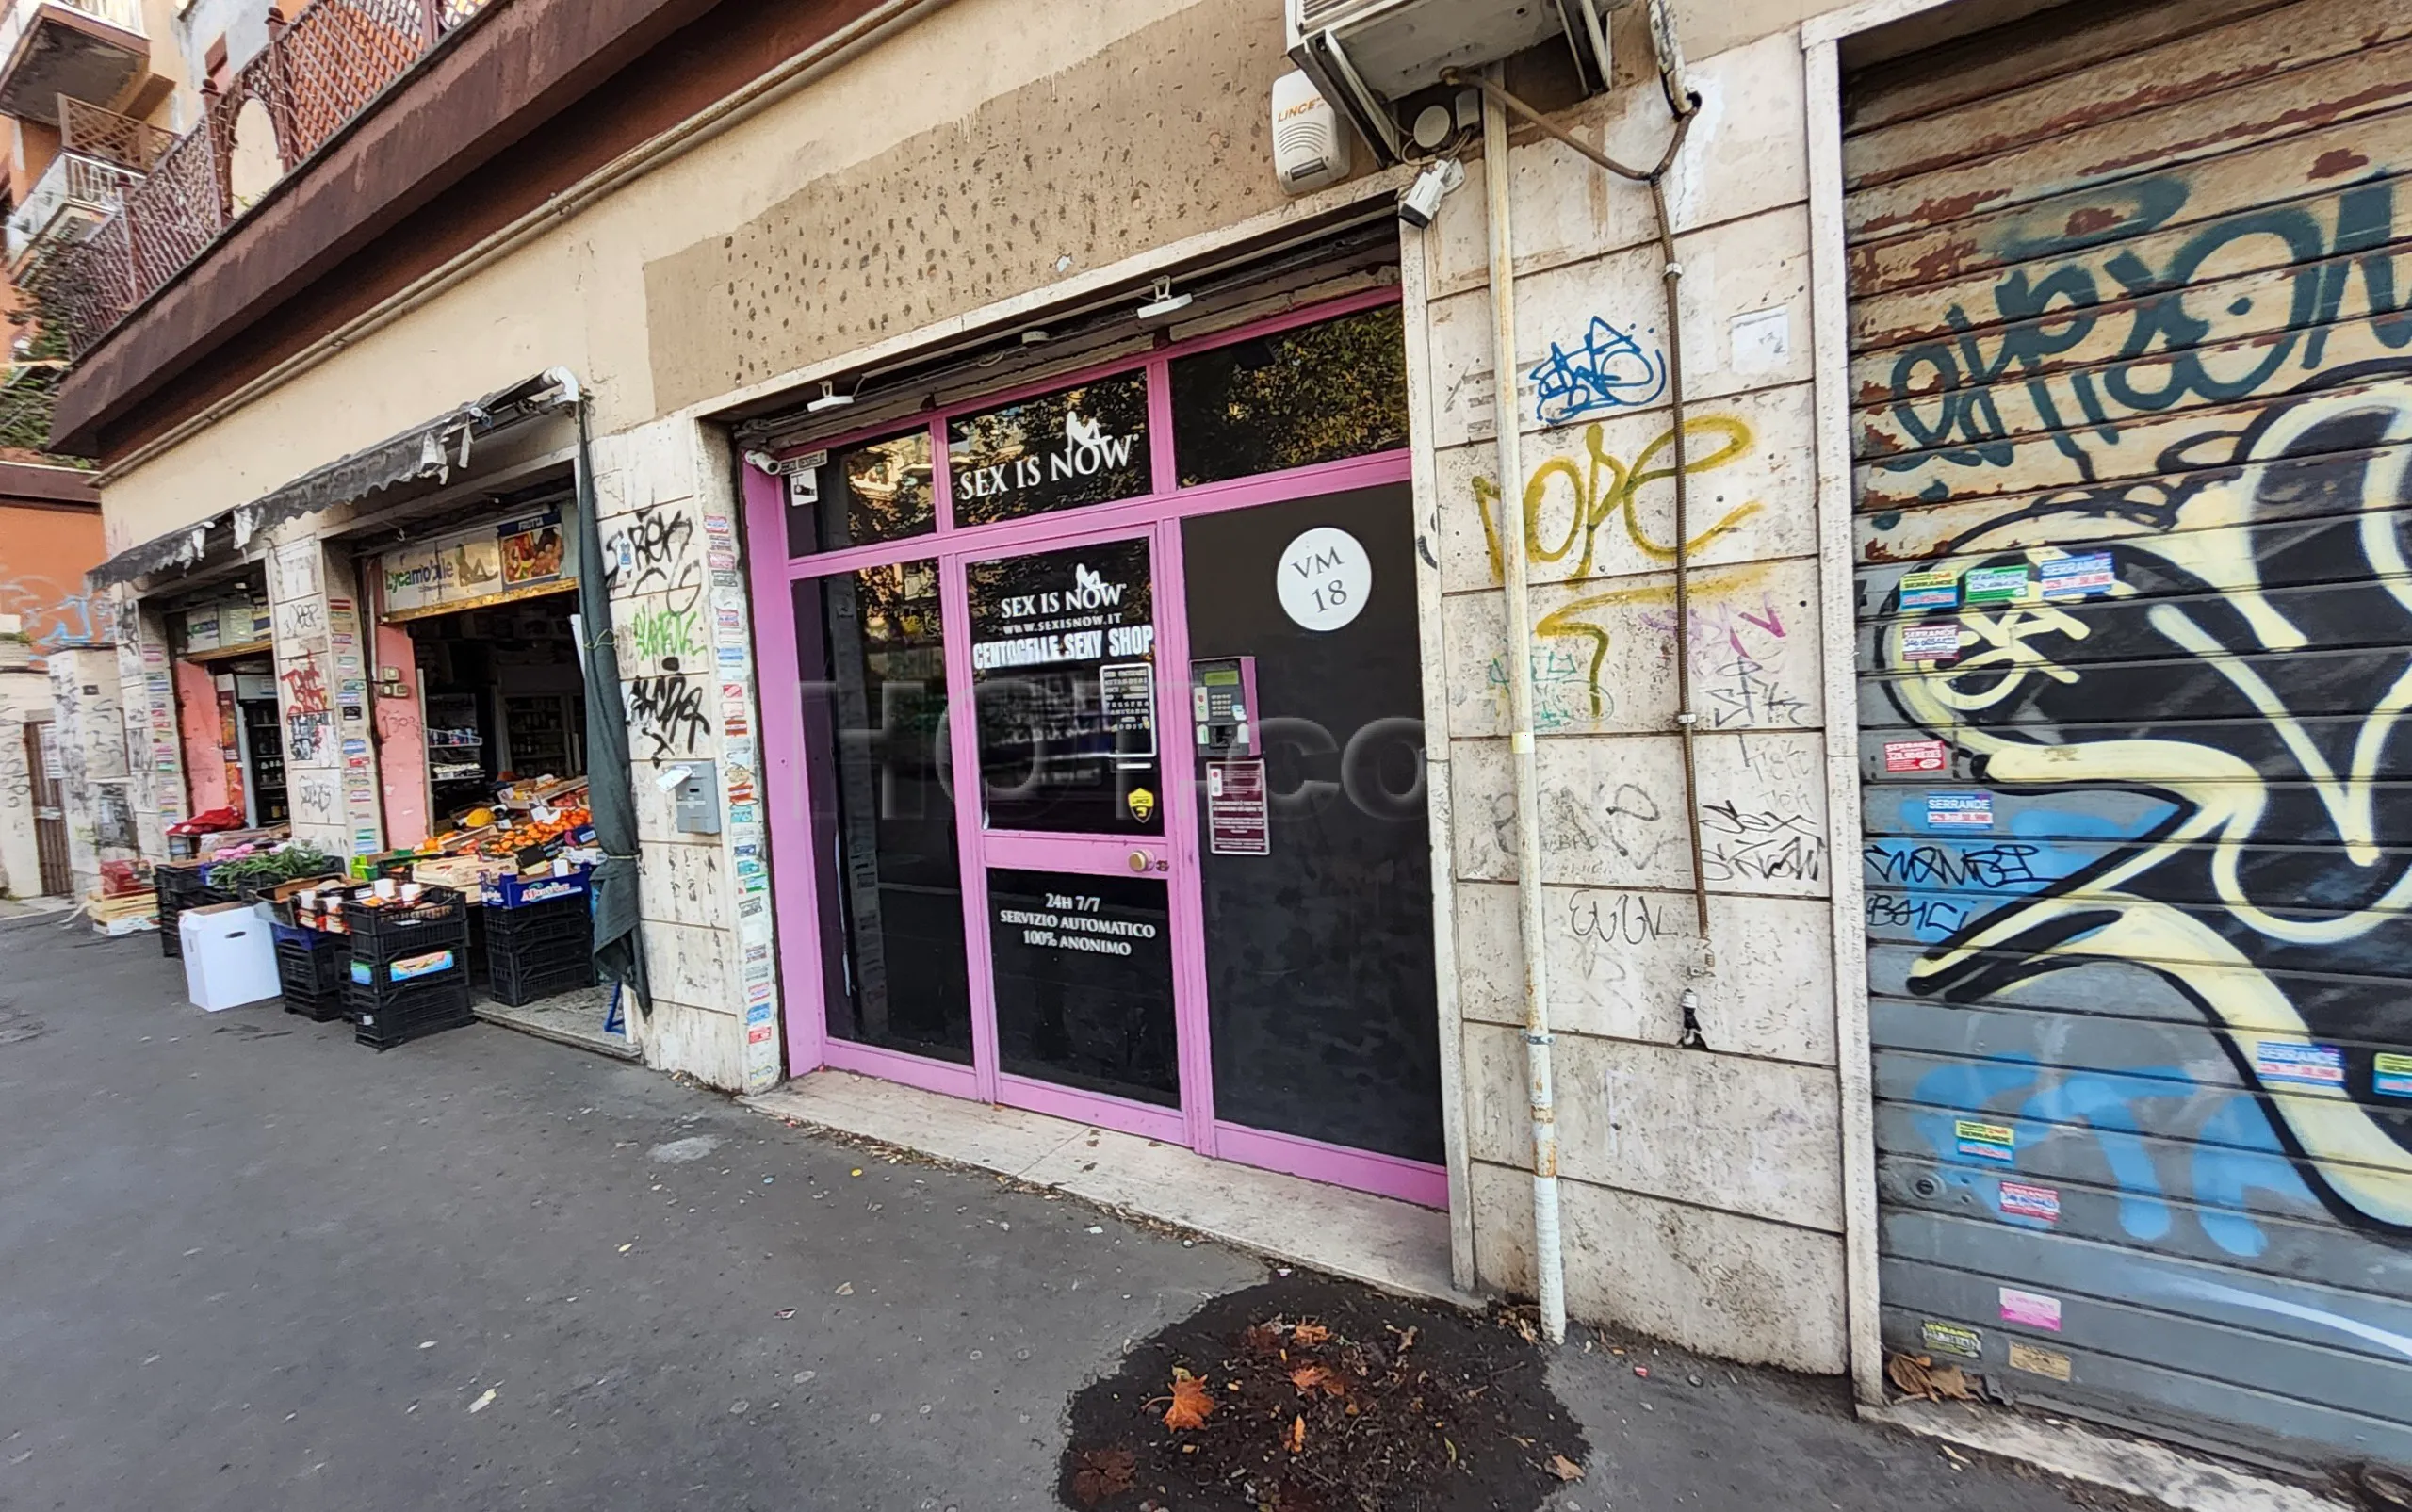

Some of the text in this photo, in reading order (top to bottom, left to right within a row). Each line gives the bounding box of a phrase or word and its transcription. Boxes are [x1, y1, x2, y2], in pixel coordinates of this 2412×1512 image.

[959, 433, 1133, 500] SEX IS NOW
[1290, 545, 1345, 579] VM
[1001, 583, 1123, 619] SEX IS NOW
[1311, 579, 1348, 614] 18
[1063, 629, 1103, 659] SEXY
[1108, 625, 1154, 657] SHOP
[1928, 799, 1991, 810] SERRANDE
[1045, 892, 1100, 912] 24H 7/7
[1000, 909, 1156, 938] SERVIZIO AUTOMATICO
[1023, 930, 1132, 956] 100% ANONIMO
